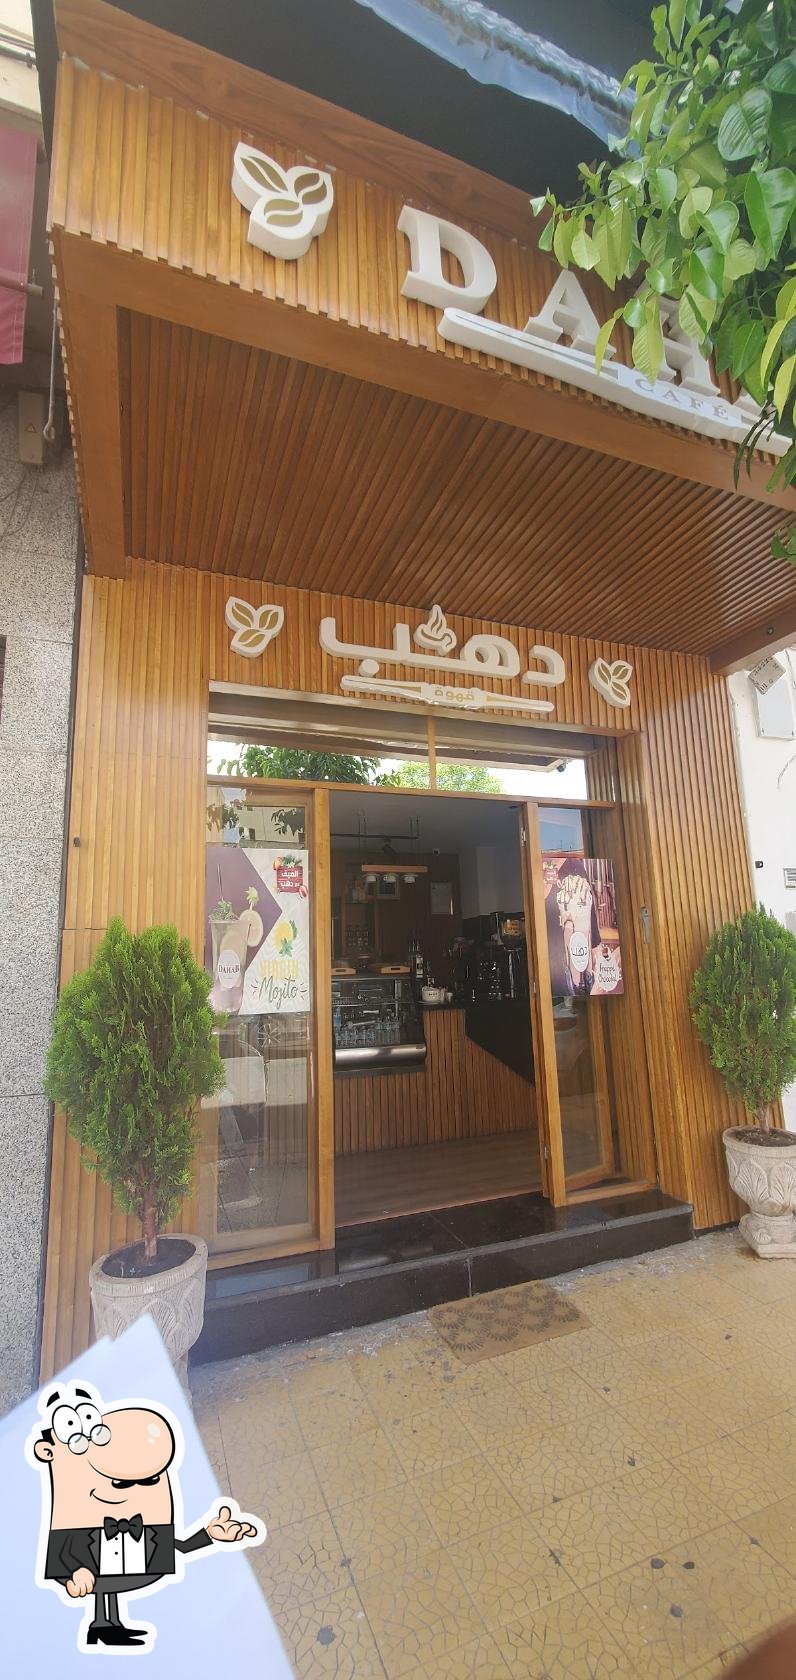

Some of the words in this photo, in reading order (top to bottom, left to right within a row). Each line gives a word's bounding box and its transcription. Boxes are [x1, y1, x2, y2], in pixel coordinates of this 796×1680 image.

[634, 378, 729, 420] CAFÉ
[319, 616, 565, 688] دهب
[434, 686, 475, 703] قهوة
[218, 964, 240, 974] DAHAB
[258, 974, 299, 1010] Mojito
